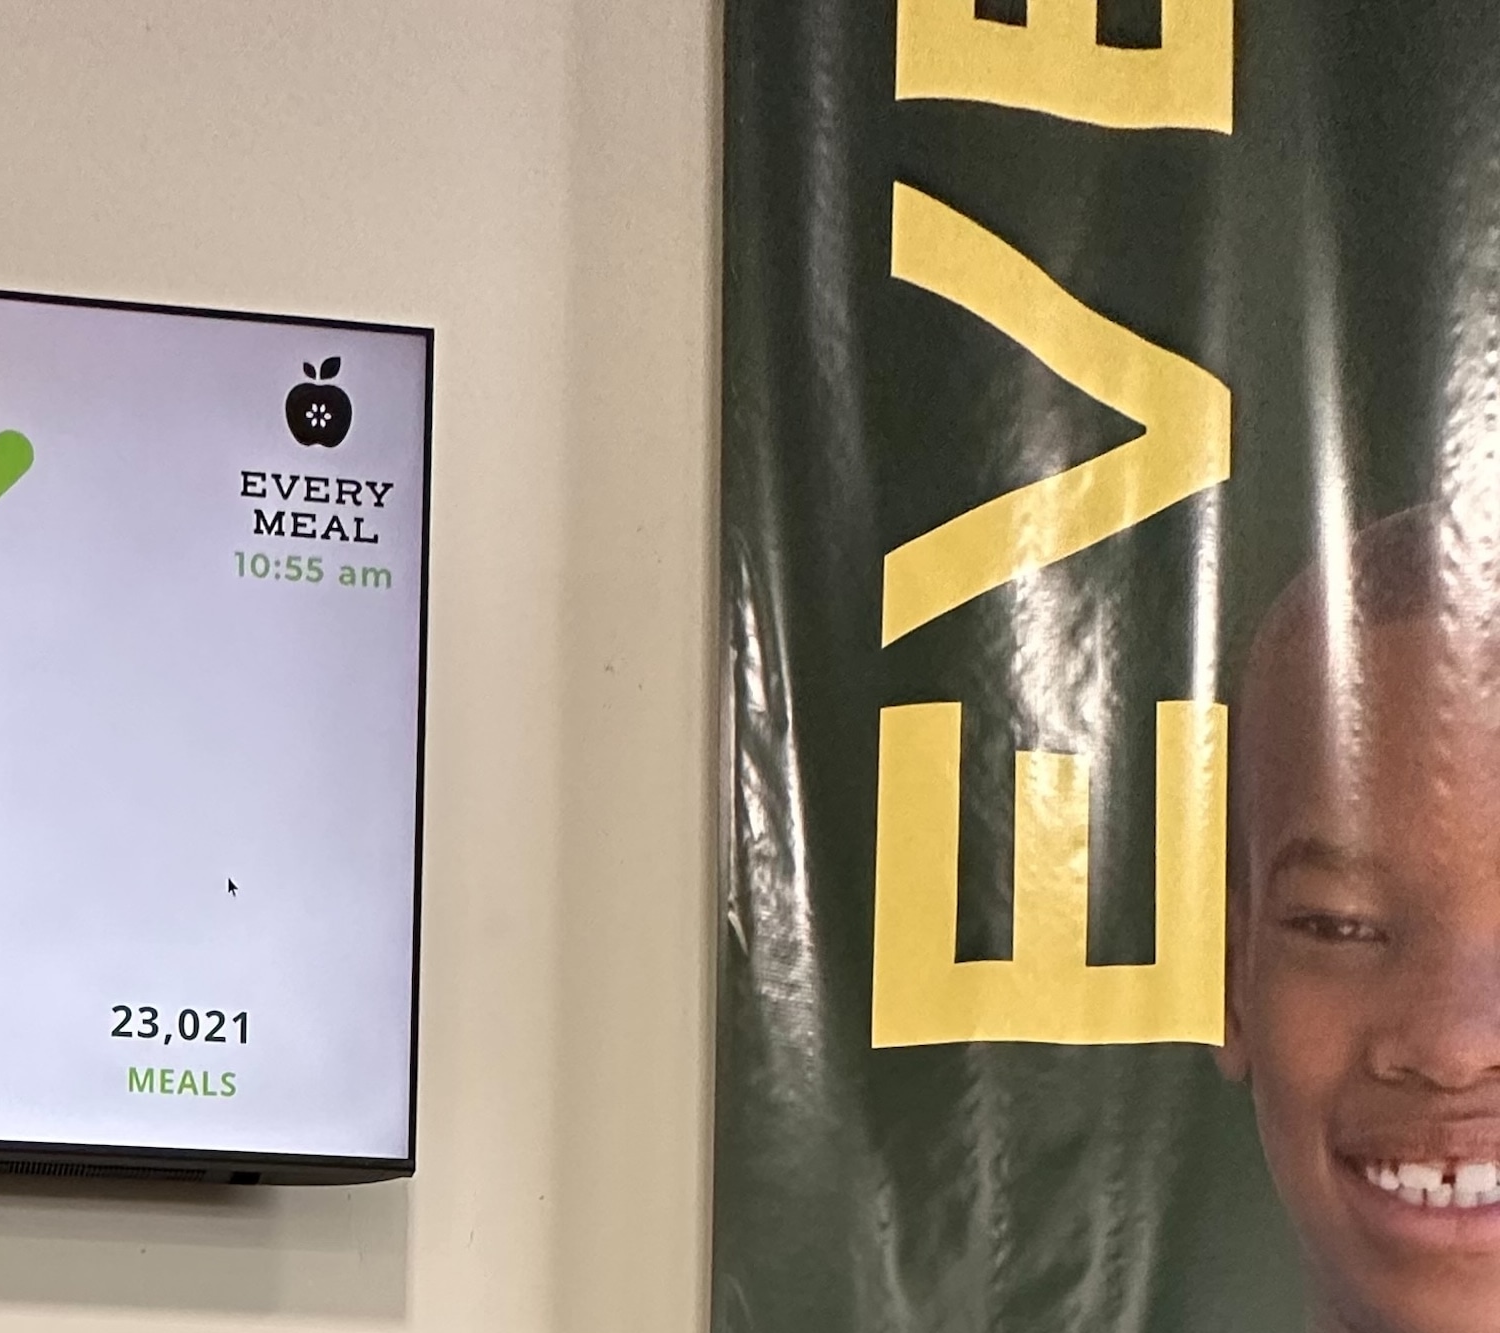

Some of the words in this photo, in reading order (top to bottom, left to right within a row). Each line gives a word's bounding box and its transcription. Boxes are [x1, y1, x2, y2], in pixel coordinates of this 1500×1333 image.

[240, 470, 394, 508] EVERY
[253, 508, 379, 544] MEAL
[234, 551, 325, 584] 10:55
[338, 564, 393, 590] am
[110, 1004, 248, 1046] 23,021
[128, 1066, 238, 1097] MEALS
